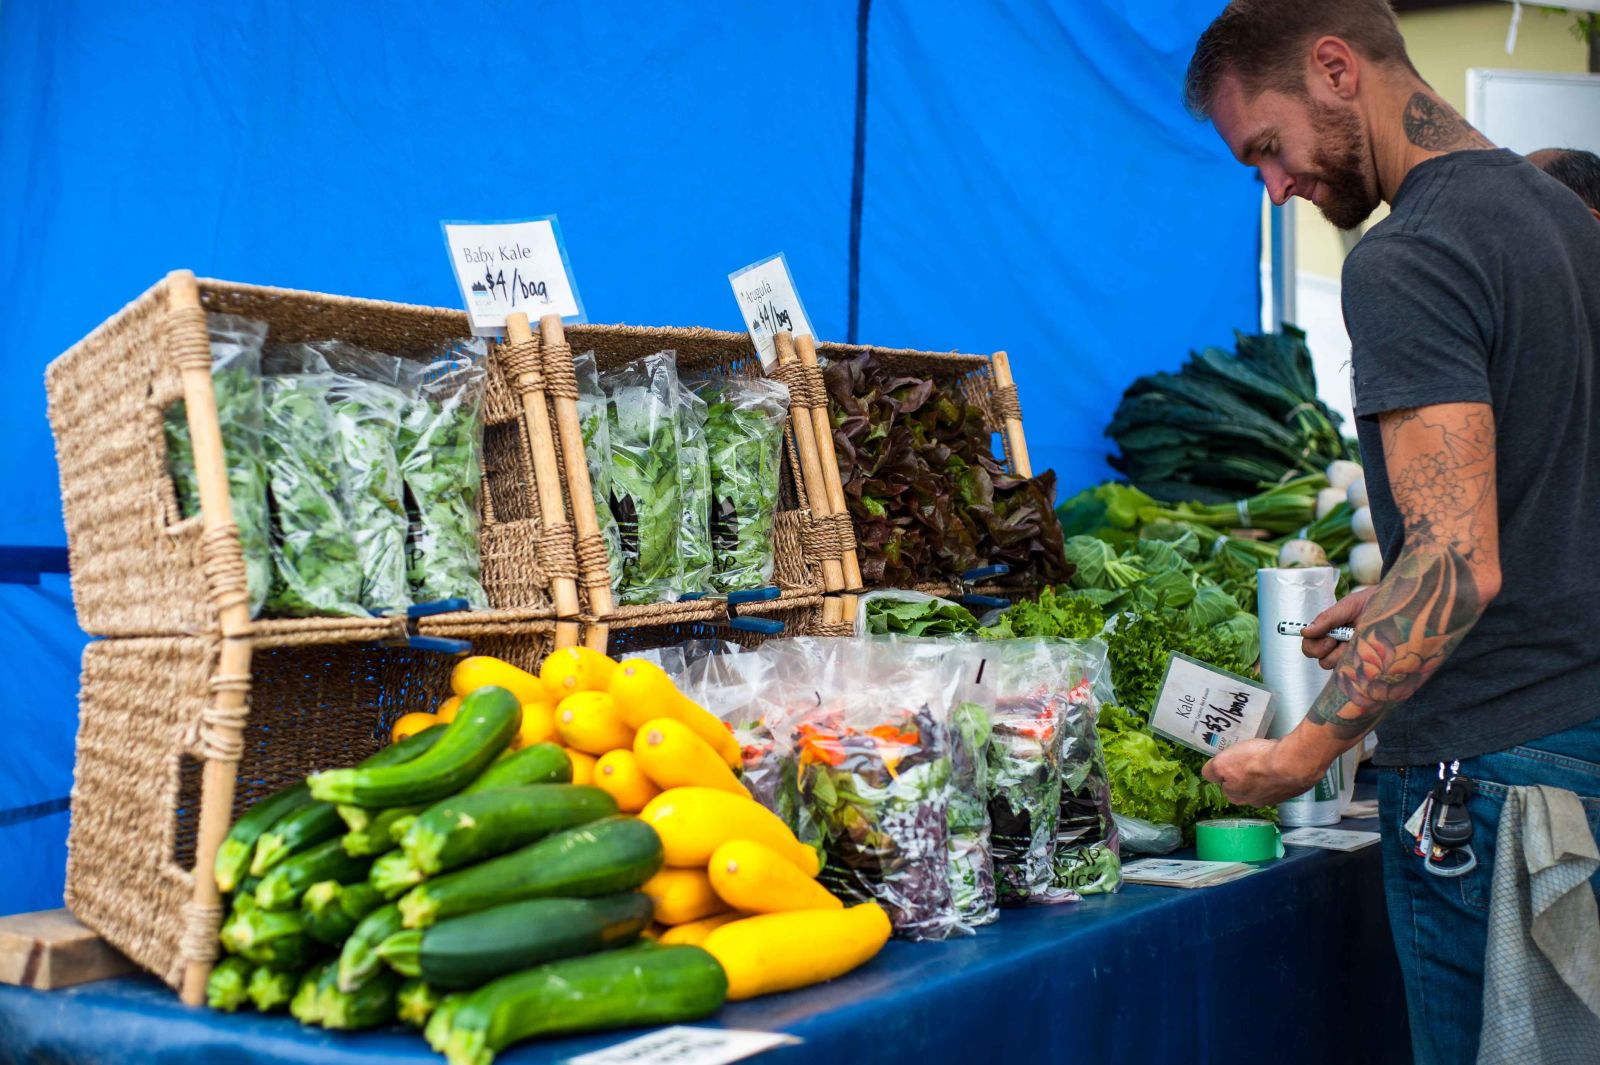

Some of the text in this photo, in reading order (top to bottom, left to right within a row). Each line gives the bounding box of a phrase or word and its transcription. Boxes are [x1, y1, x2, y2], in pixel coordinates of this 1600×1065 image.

[463, 243, 532, 267] Baby Kale
[485, 263, 552, 307] $4/bag
[745, 280, 772, 303] Arugula
[1175, 694, 1195, 719] Kale
